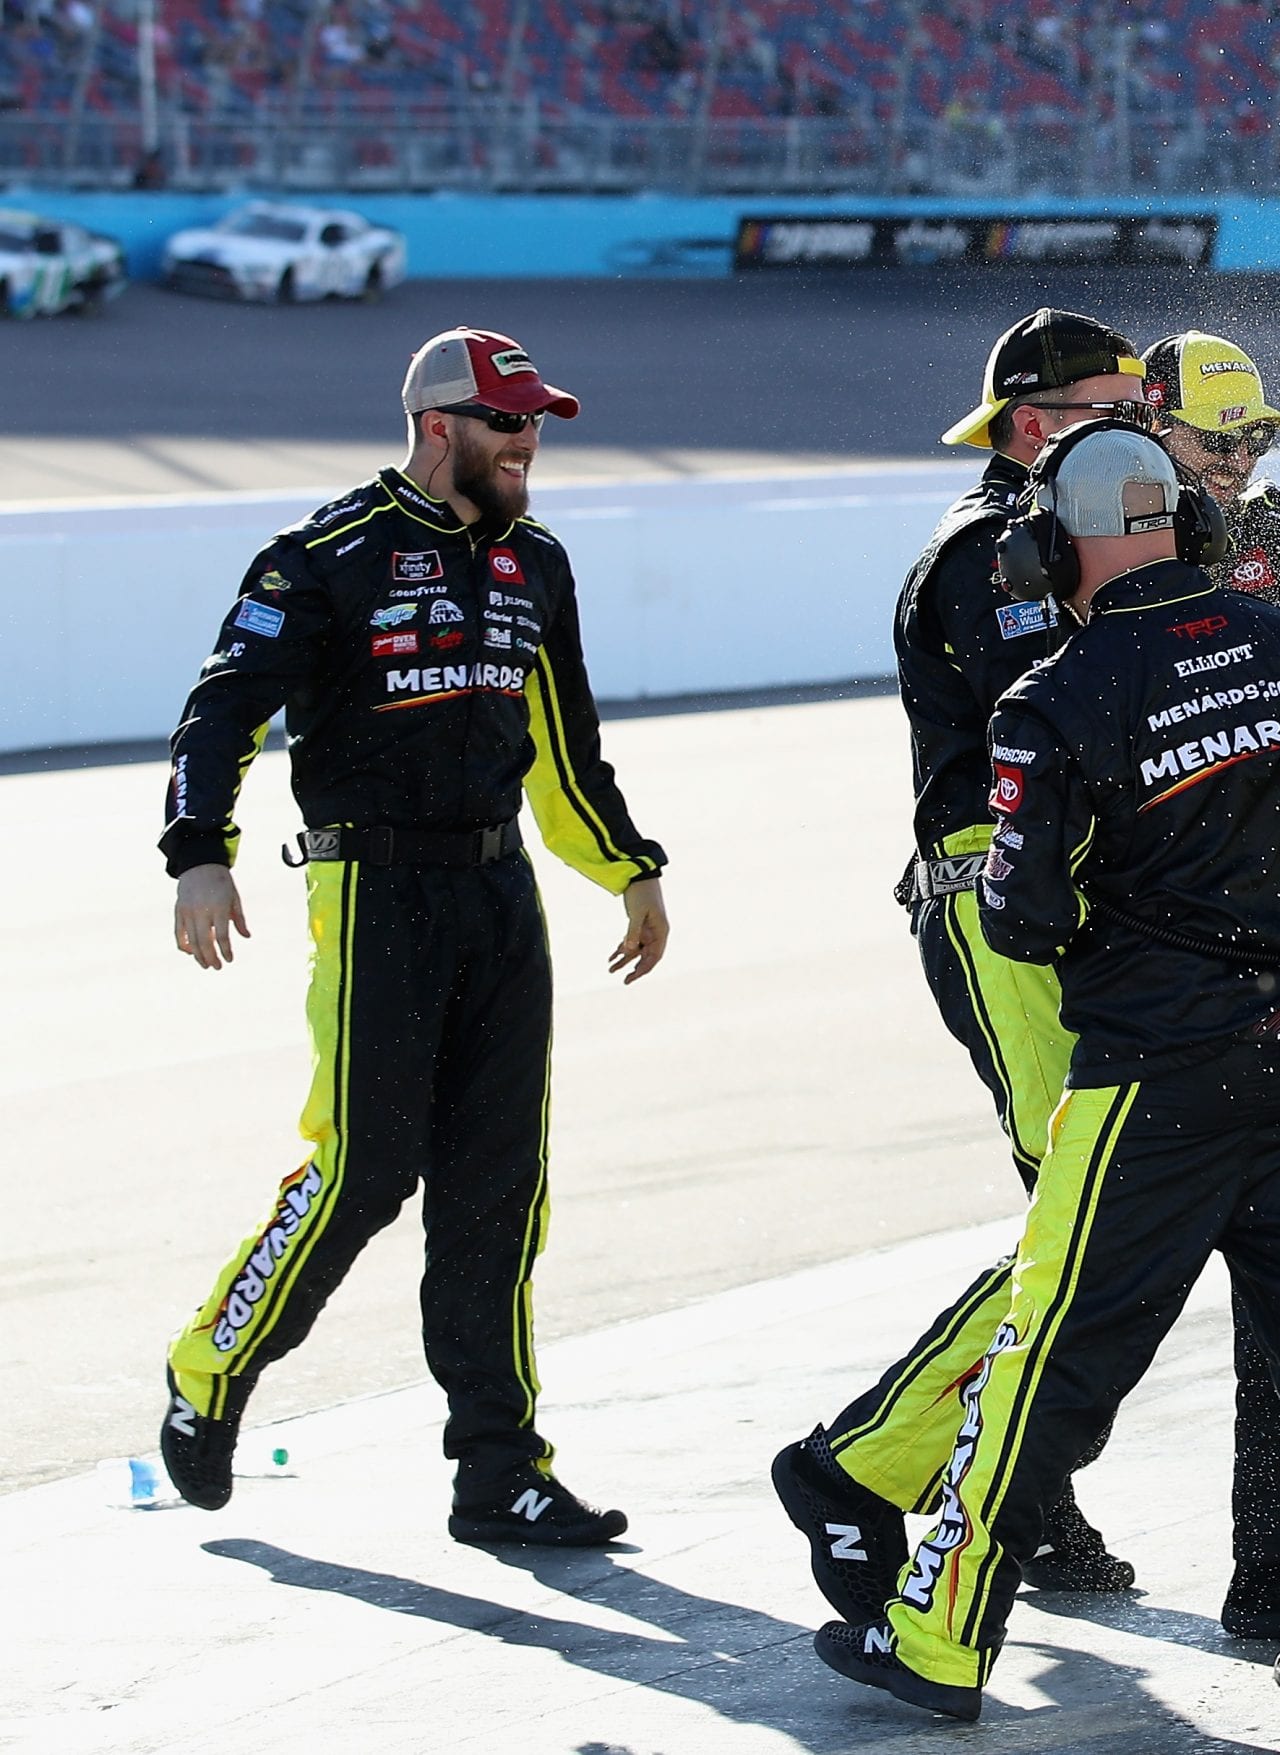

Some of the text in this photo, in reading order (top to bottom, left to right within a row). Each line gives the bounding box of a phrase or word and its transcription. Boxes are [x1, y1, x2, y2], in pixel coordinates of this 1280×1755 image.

[1138, 517, 1168, 529] TRD
[389, 585, 448, 597] GOODYEAR
[428, 612, 465, 624] ATLAS
[1167, 615, 1229, 640] TRD
[491, 627, 512, 644] Bali
[1174, 644, 1255, 678] ELLIOTT
[386, 663, 525, 692] MENARDS
[169, 1395, 197, 1438] N
[511, 1487, 554, 1522] N
[825, 1521, 869, 1562] N
[863, 1626, 891, 1654] N
